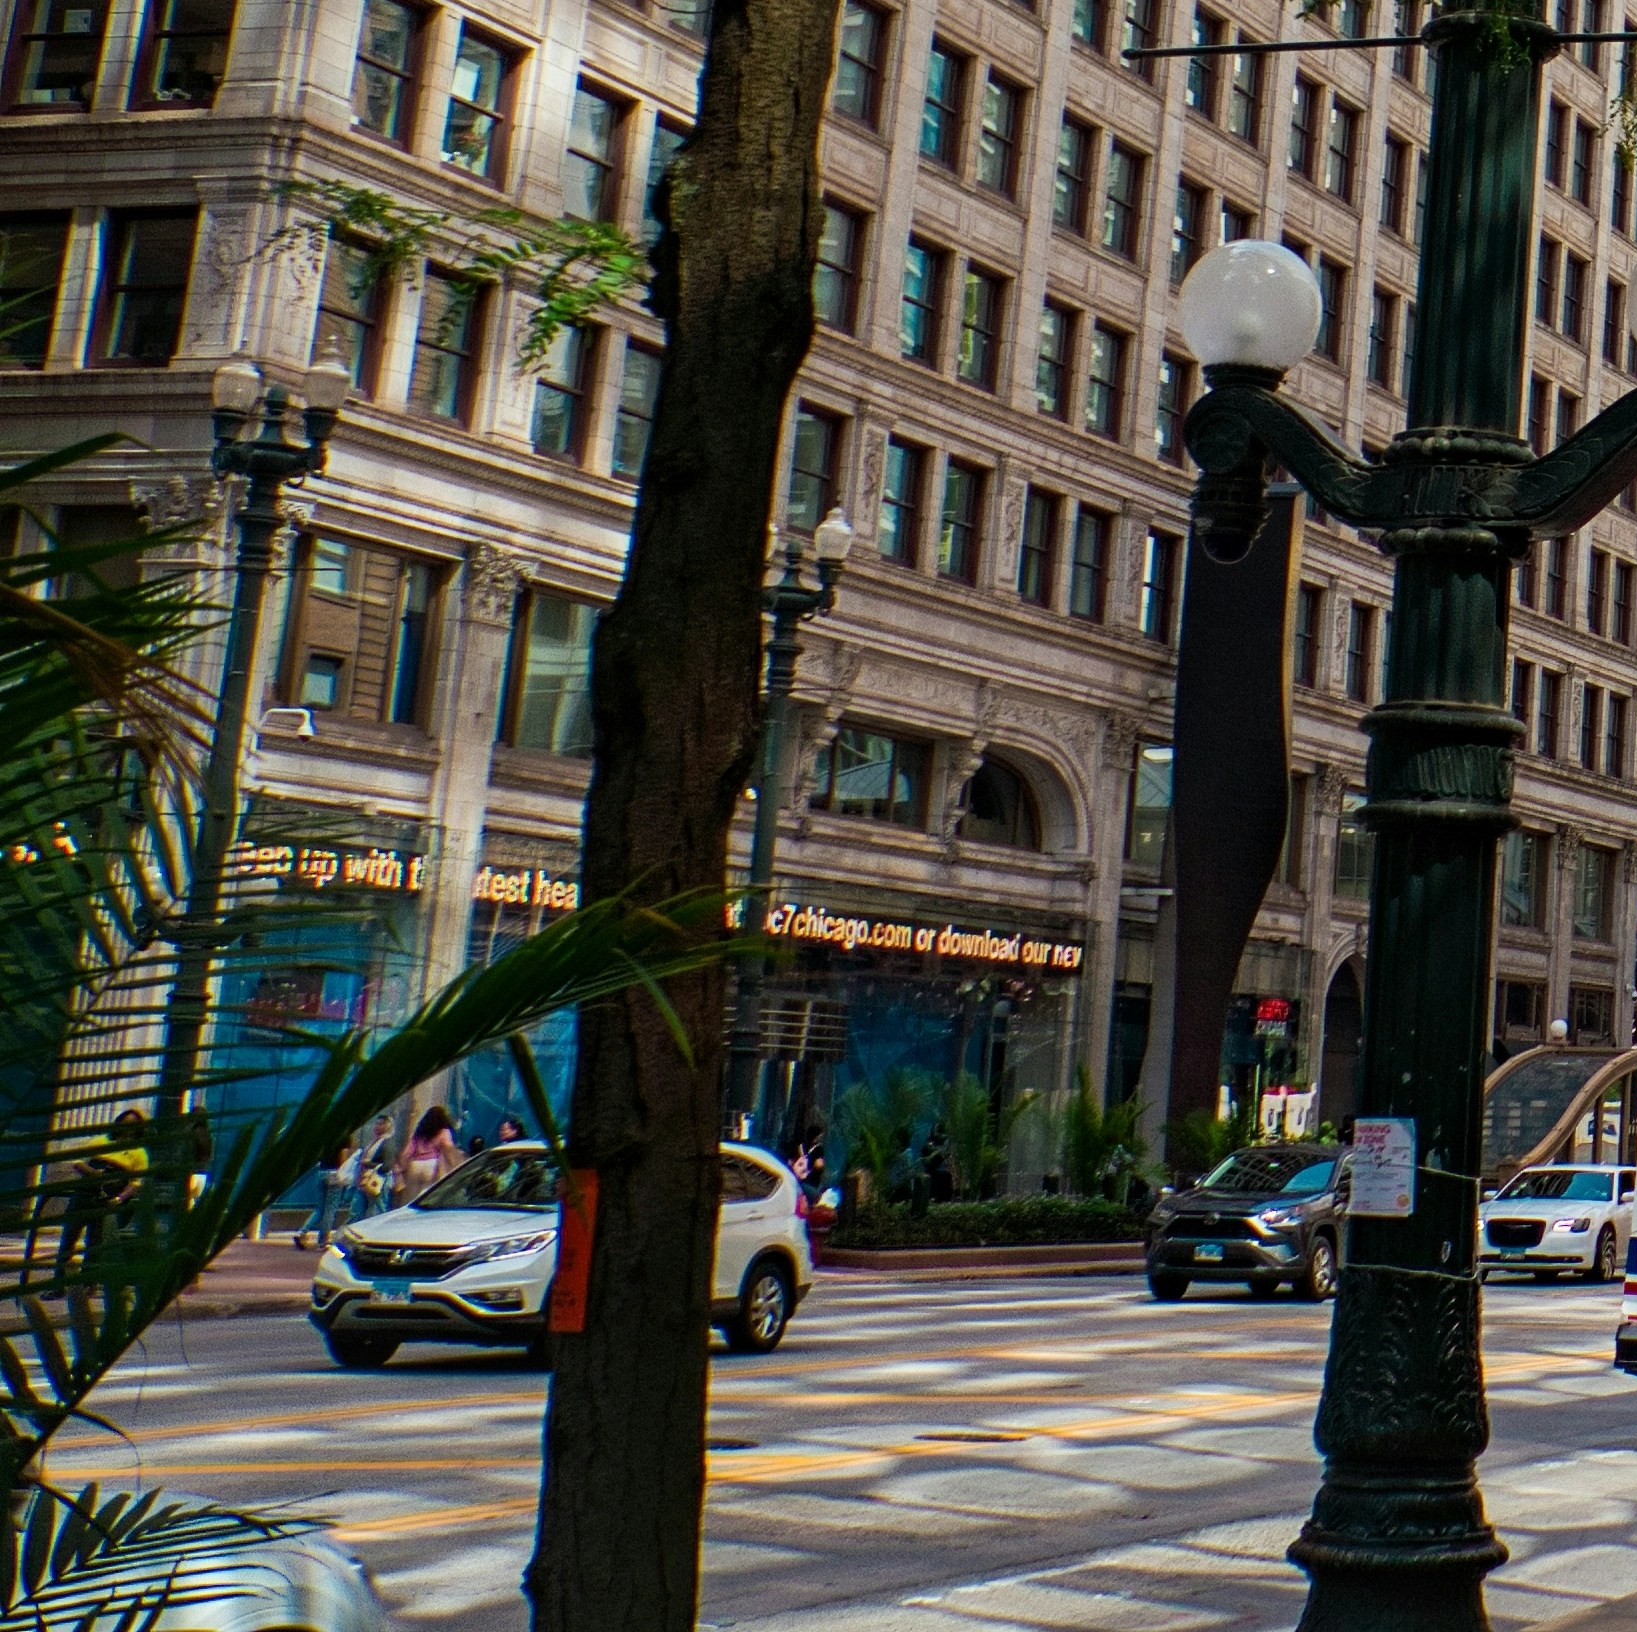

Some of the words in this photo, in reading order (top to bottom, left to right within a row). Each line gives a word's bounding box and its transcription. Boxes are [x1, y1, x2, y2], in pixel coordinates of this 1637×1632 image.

[916, 927, 936, 952] or
[939, 925, 1019, 961] download
[1023, 941, 1050, 964] our
